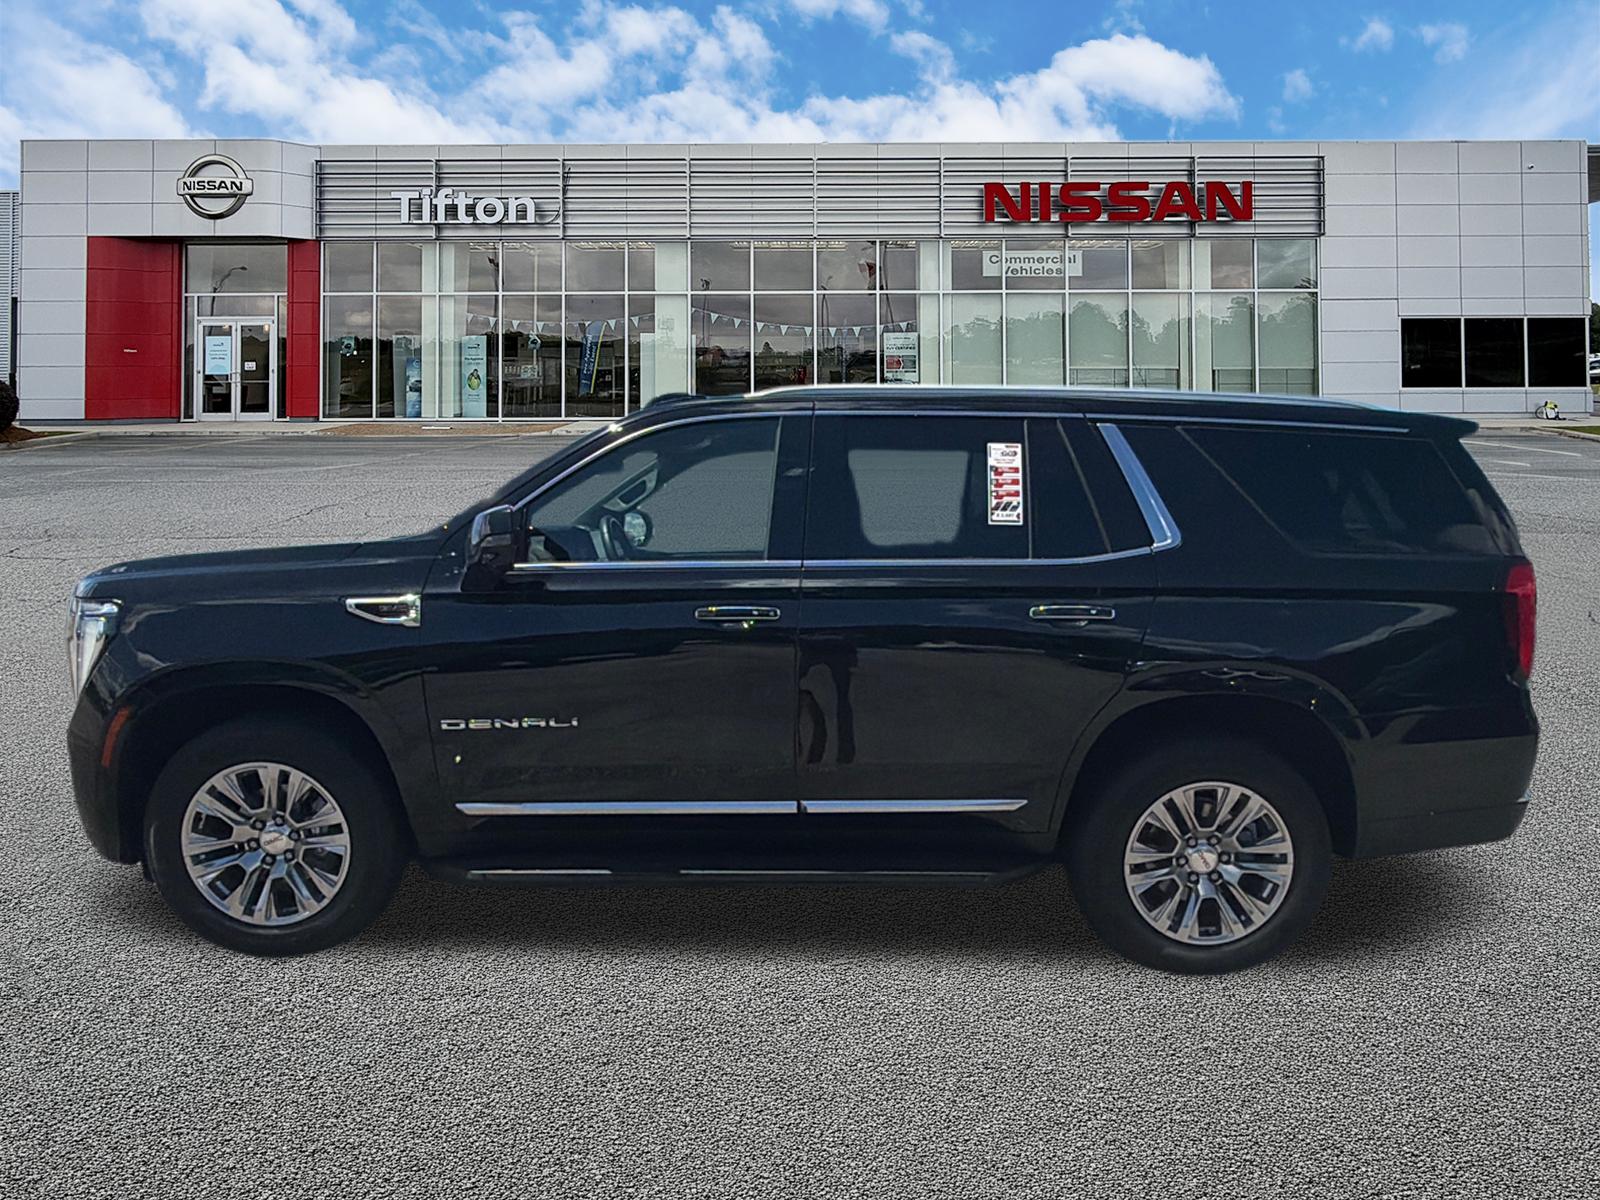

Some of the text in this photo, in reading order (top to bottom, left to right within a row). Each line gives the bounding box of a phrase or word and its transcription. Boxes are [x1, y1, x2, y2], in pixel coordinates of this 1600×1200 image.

[182, 180, 243, 192] NISSAN
[390, 187, 537, 225] Tifton
[983, 181, 1254, 223] NISSAN
[440, 717, 578, 730] DENALI
